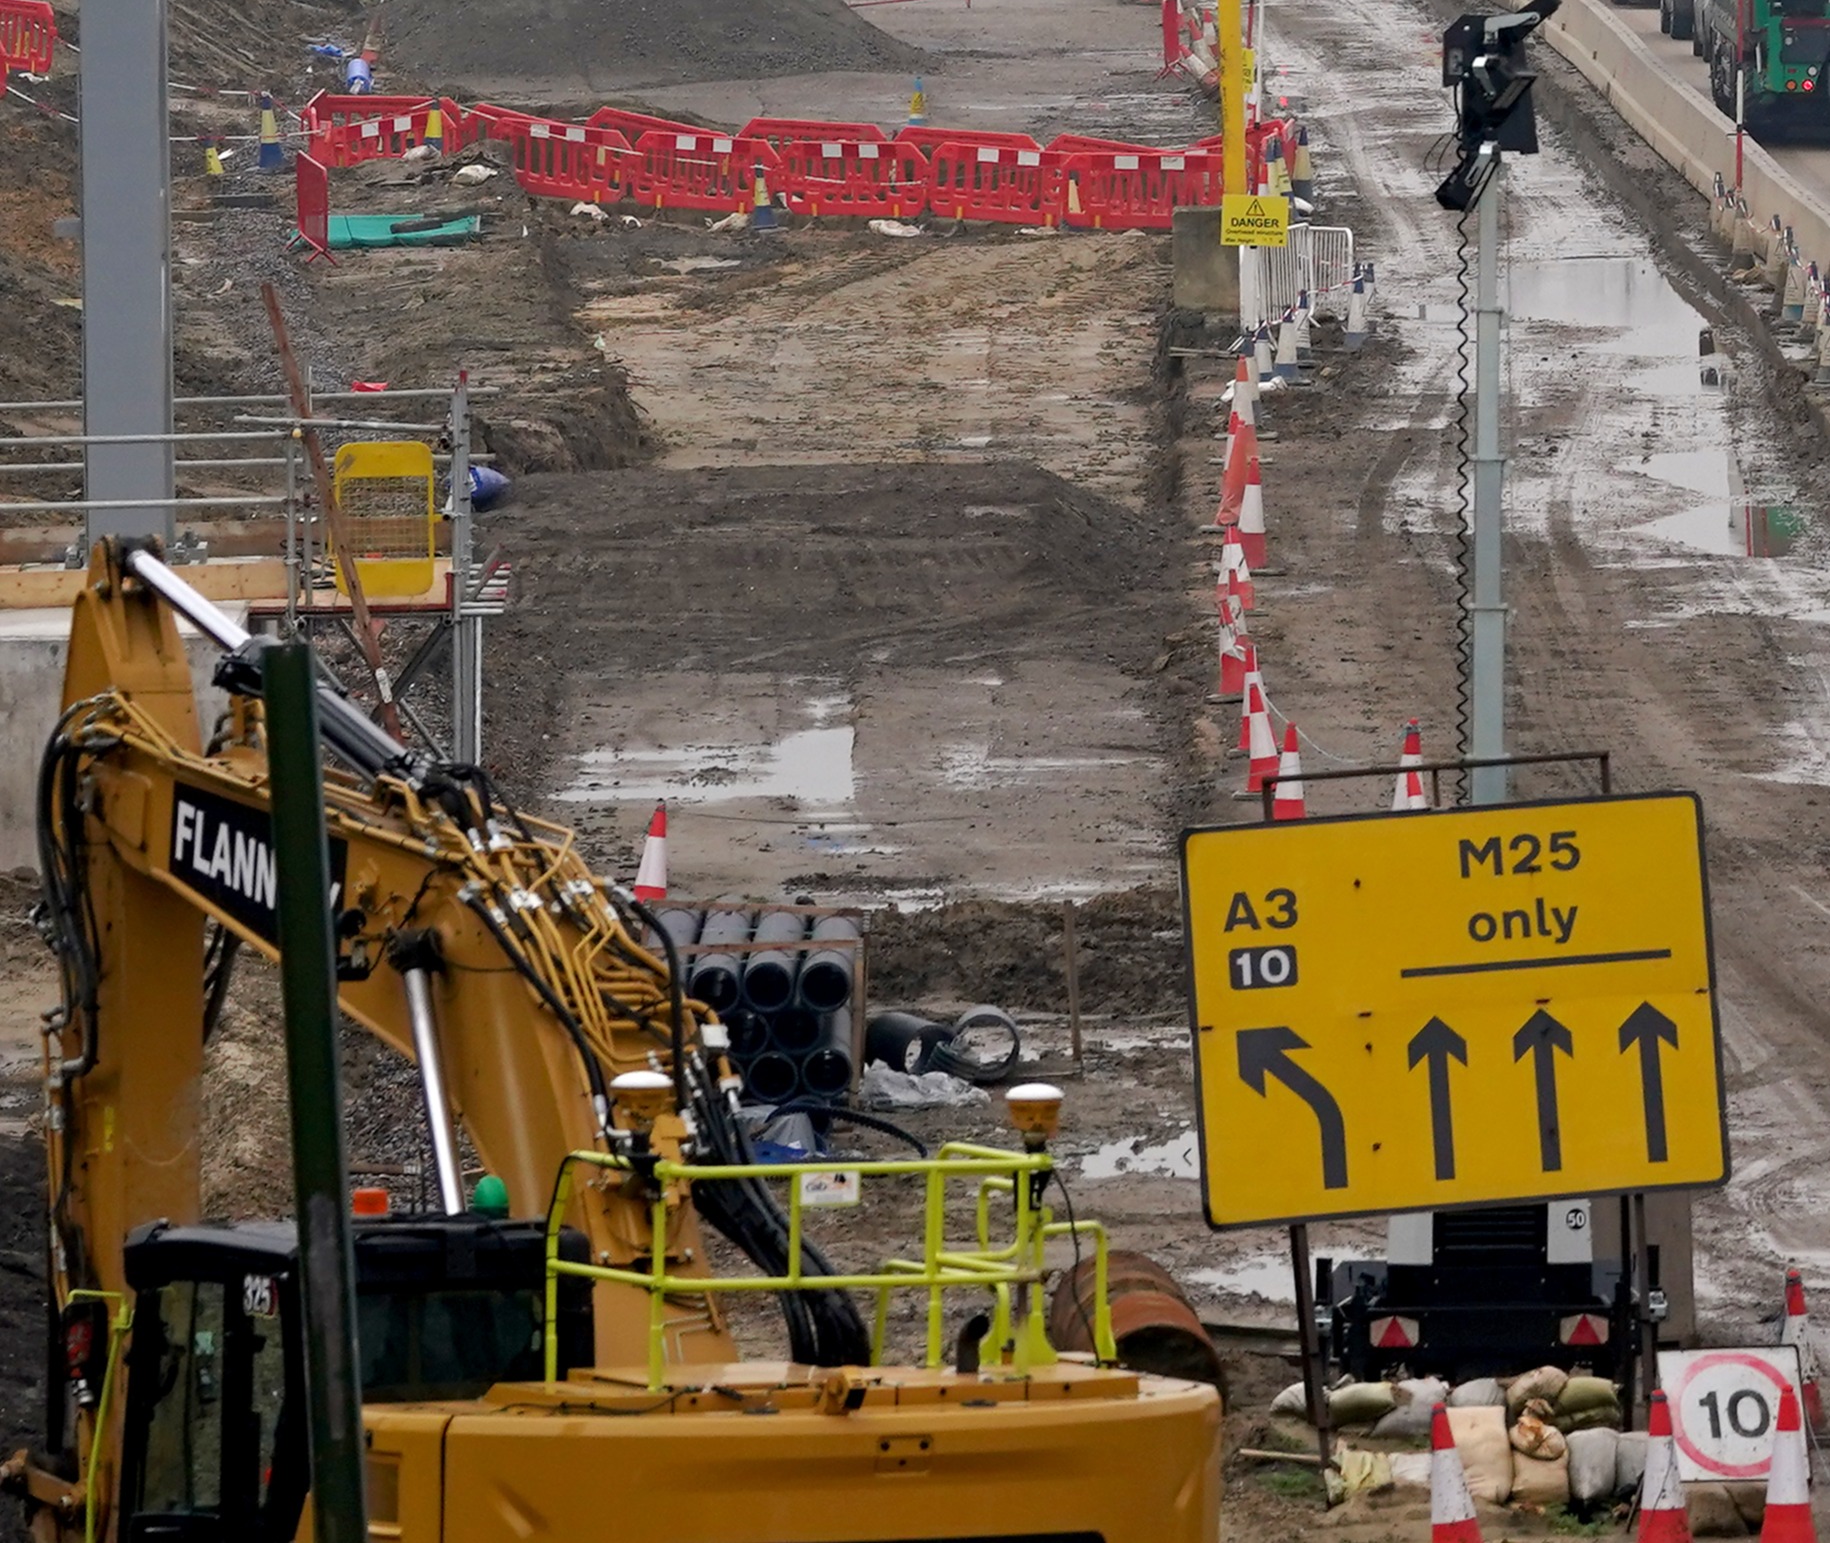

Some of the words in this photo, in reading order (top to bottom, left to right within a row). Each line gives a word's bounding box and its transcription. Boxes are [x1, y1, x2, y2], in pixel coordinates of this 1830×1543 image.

[1231, 217, 1280, 228] DANGER
[1457, 830, 1581, 879] M25
[1223, 887, 1299, 934] A3
[1467, 897, 1579, 944] only
[1235, 948, 1292, 988] 10
[1567, 1211, 1585, 1227] 50
[1698, 1388, 1771, 1439] 10
